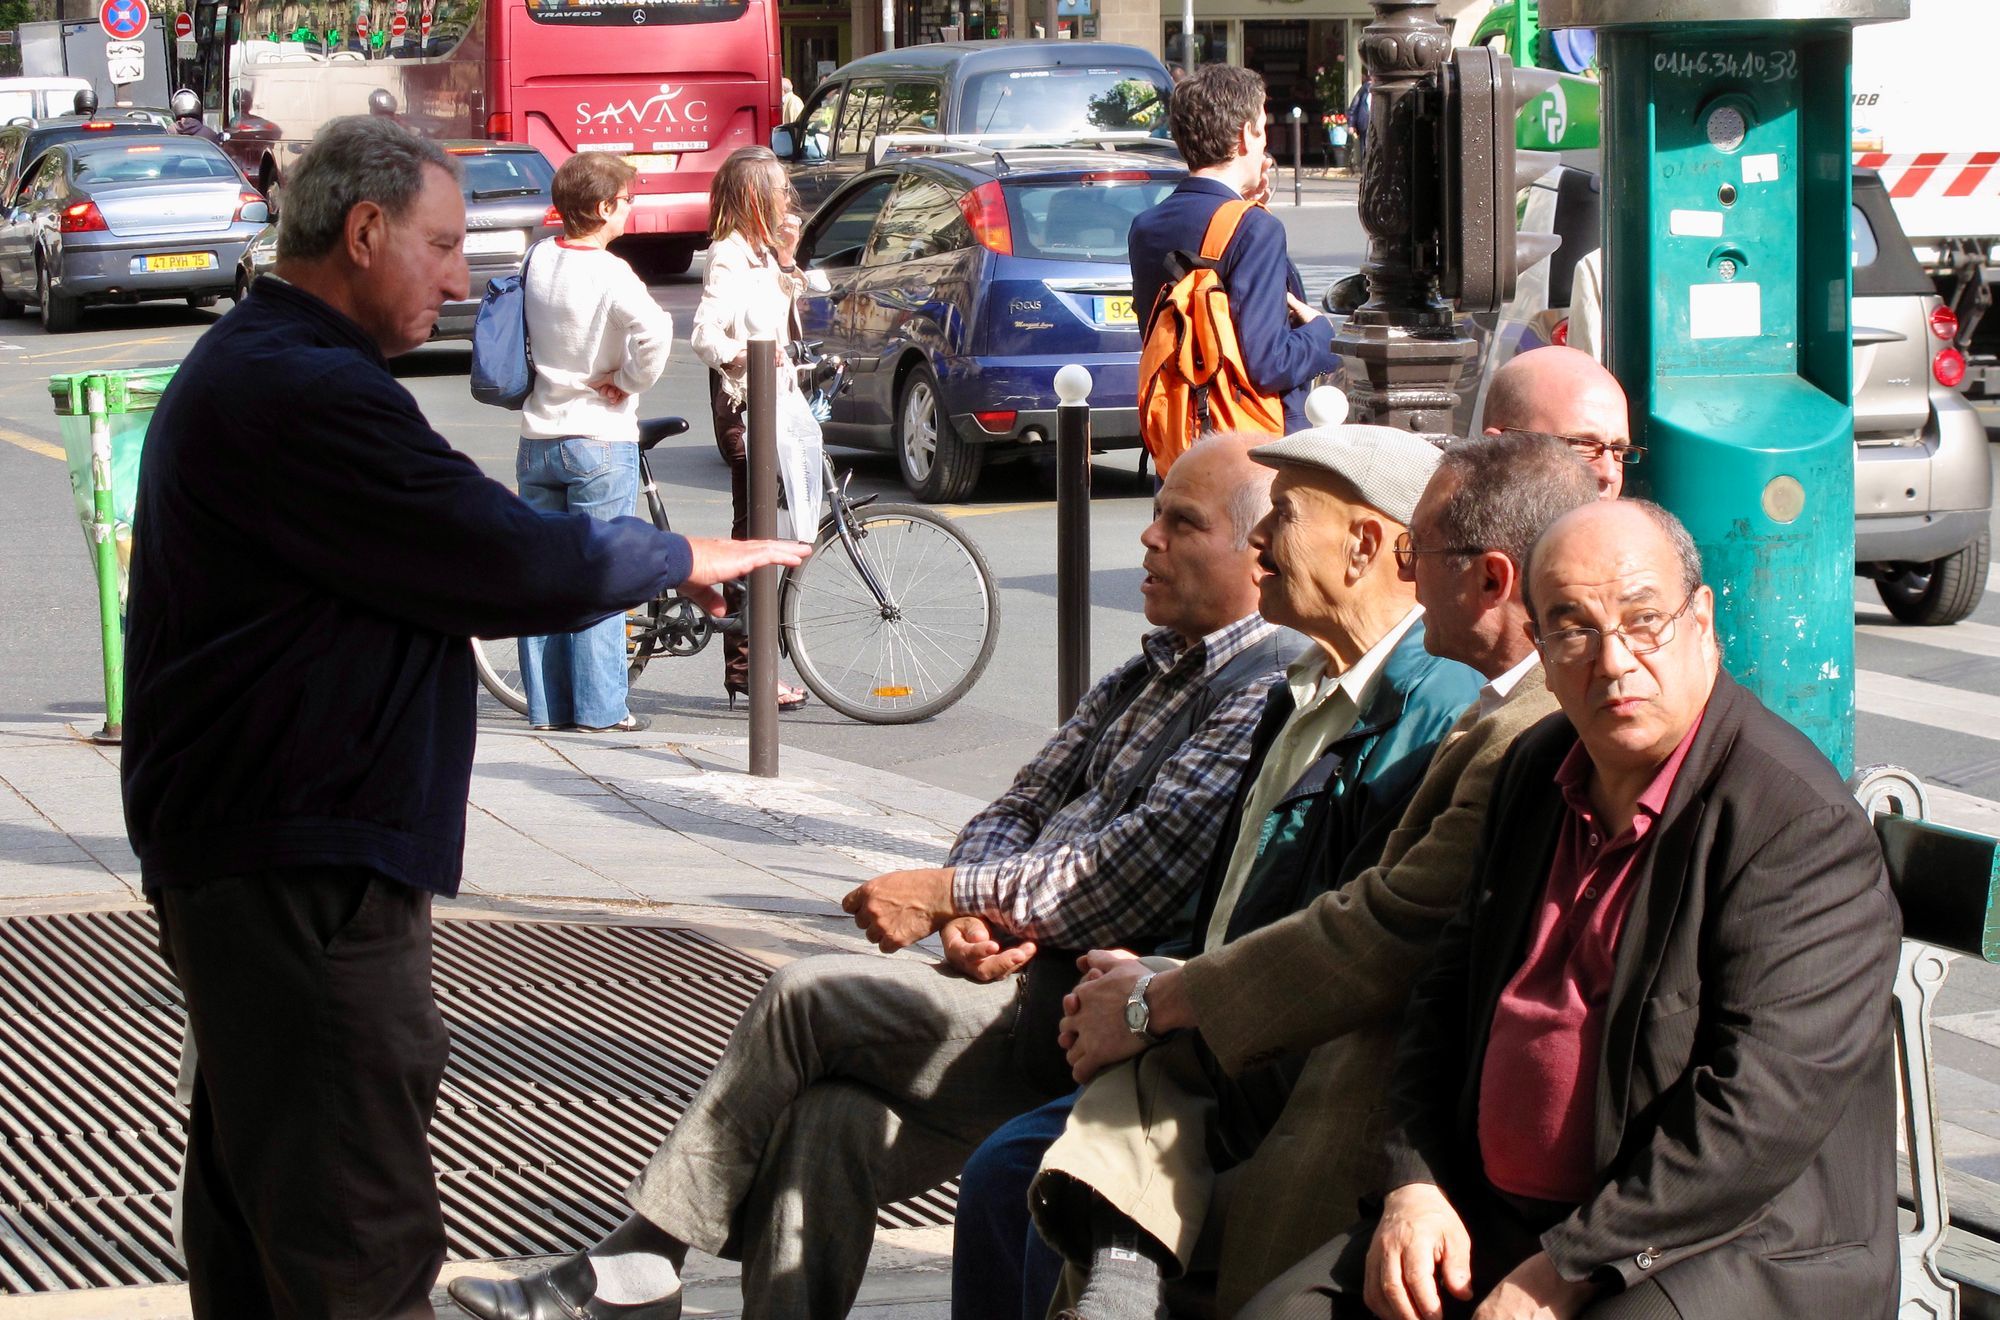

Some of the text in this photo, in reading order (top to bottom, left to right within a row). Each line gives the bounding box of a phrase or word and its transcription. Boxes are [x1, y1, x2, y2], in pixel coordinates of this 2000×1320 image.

[576, 87, 708, 125] SAVAC
[576, 125, 708, 135] PARIS NICE
[153, 257, 166, 269] 47
[193, 255, 205, 267] 75
[1111, 301, 1134, 318] 92
